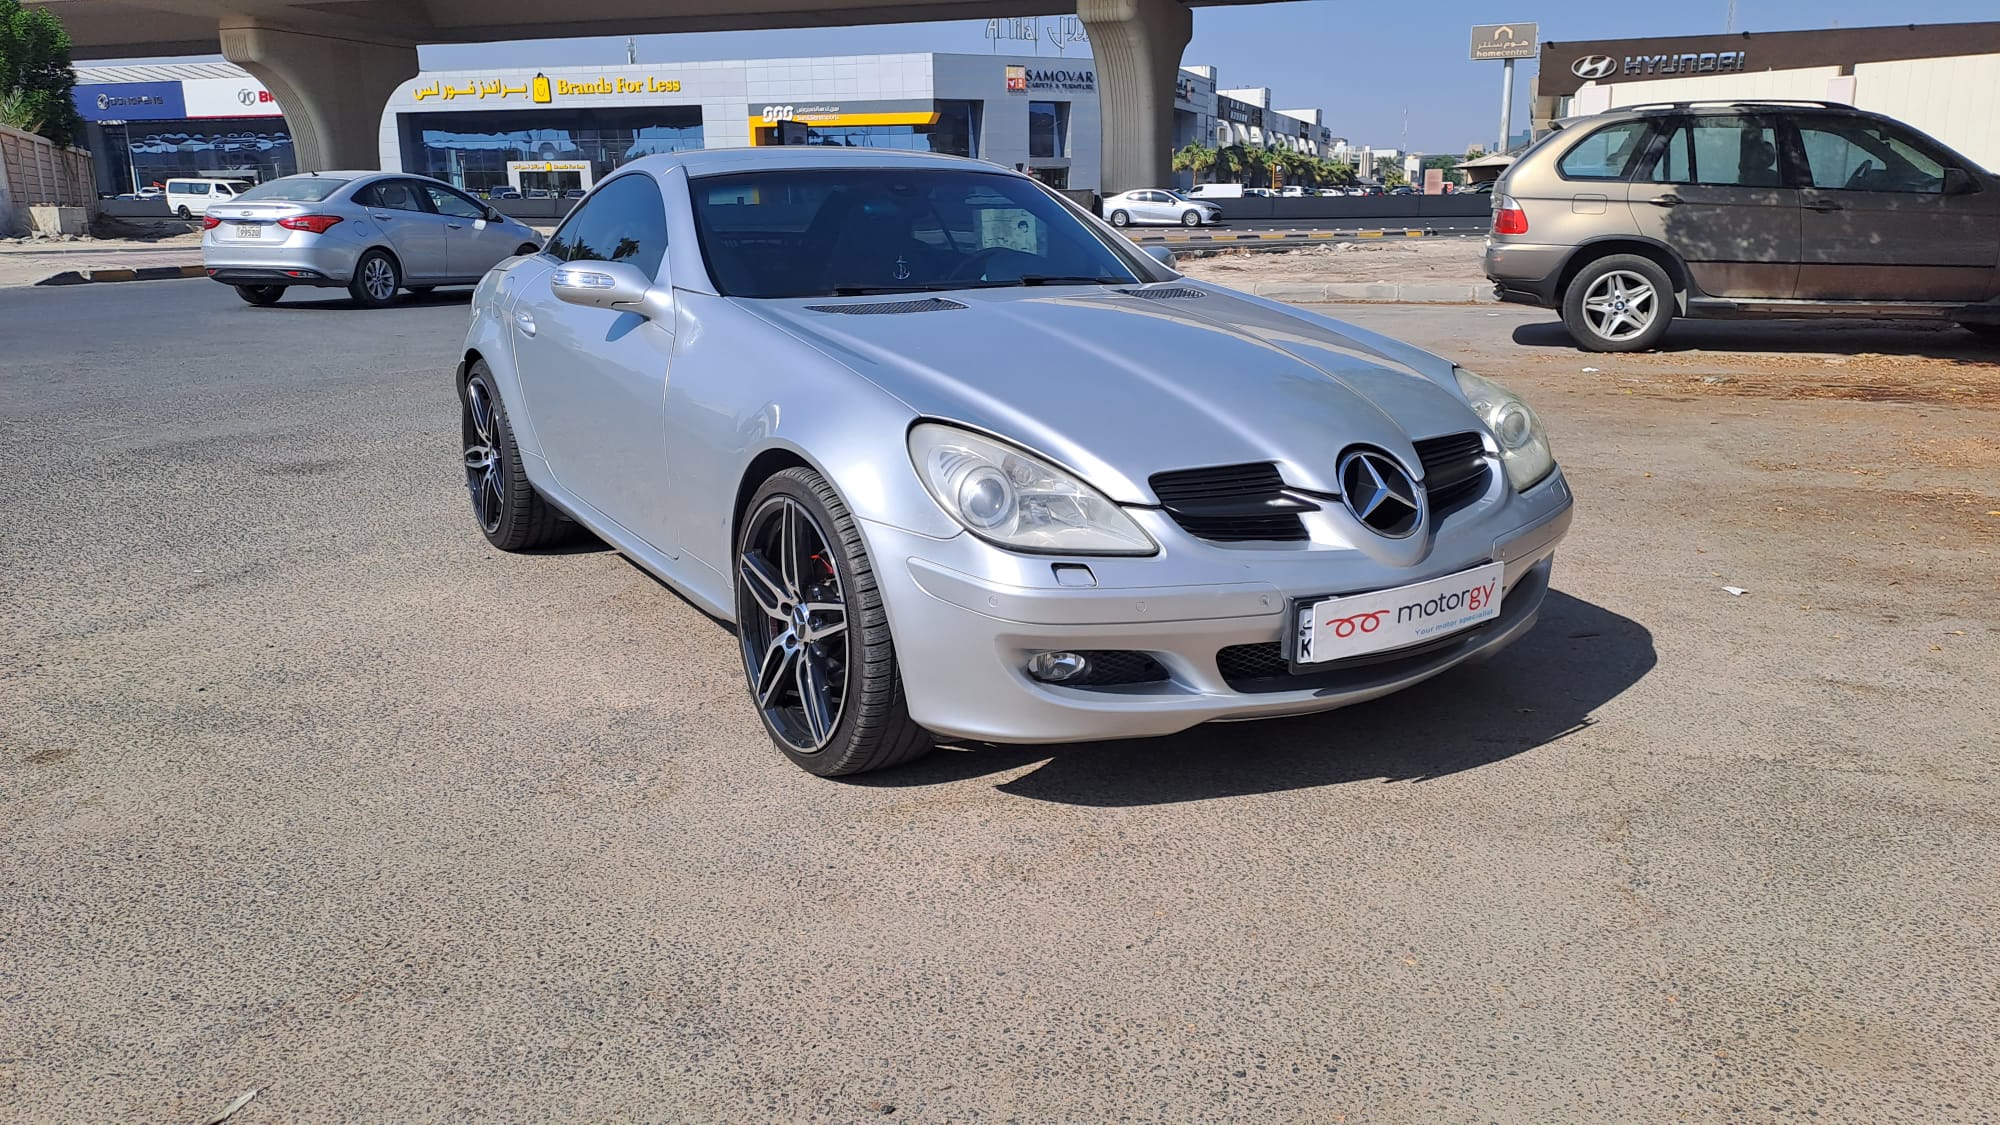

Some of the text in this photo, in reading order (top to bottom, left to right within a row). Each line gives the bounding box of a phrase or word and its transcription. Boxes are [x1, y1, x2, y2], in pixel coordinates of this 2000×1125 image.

[1476, 49, 1528, 57] homecentre
[1624, 51, 1745, 75] HYUNDAI
[557, 76, 681, 95] Brands For Less
[1026, 70, 1093, 85] SAMOVAR
[414, 79, 528, 100] براندز فور لس
[1397, 577, 1496, 624] motorgy
[1414, 609, 1494, 637] Your motor specialist
